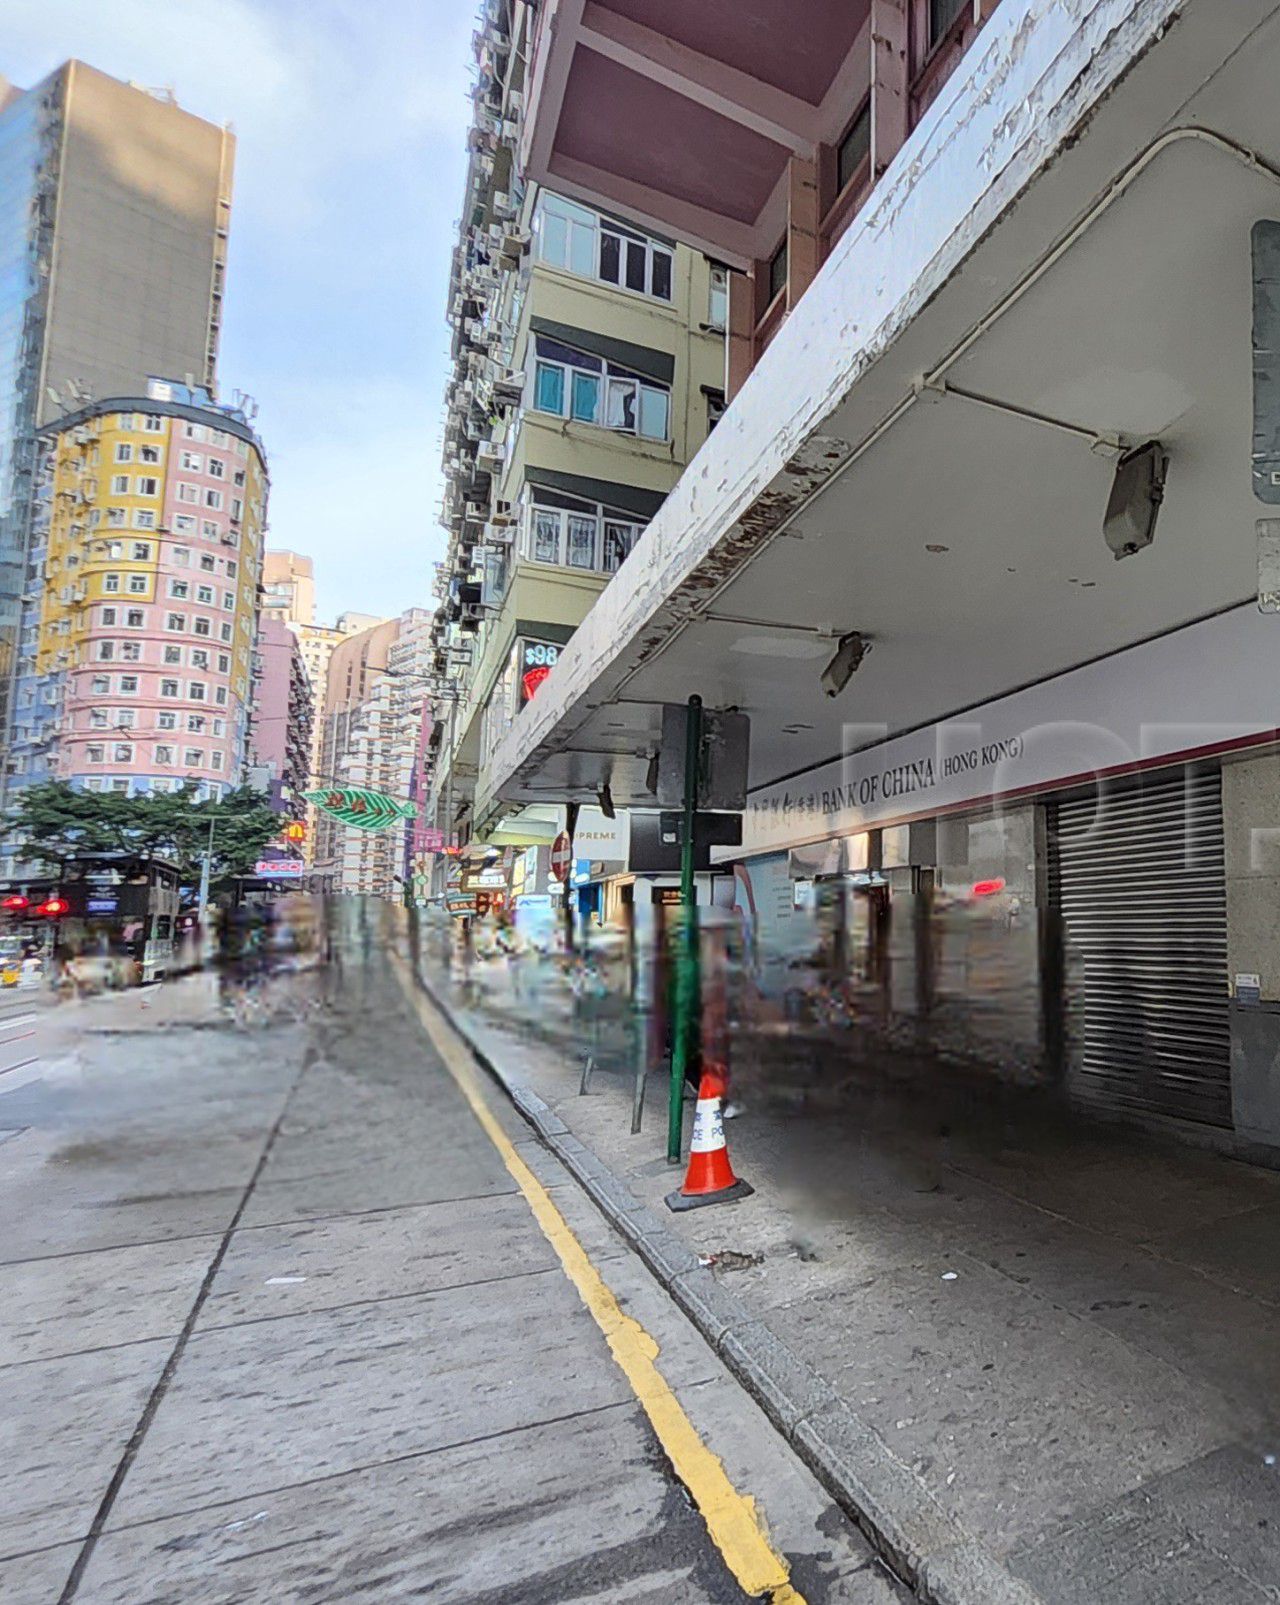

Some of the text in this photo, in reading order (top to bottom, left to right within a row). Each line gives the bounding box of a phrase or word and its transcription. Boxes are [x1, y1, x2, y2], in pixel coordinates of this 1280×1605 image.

[822, 735, 1025, 815] BANK OF CHINA (HONG KONG)
